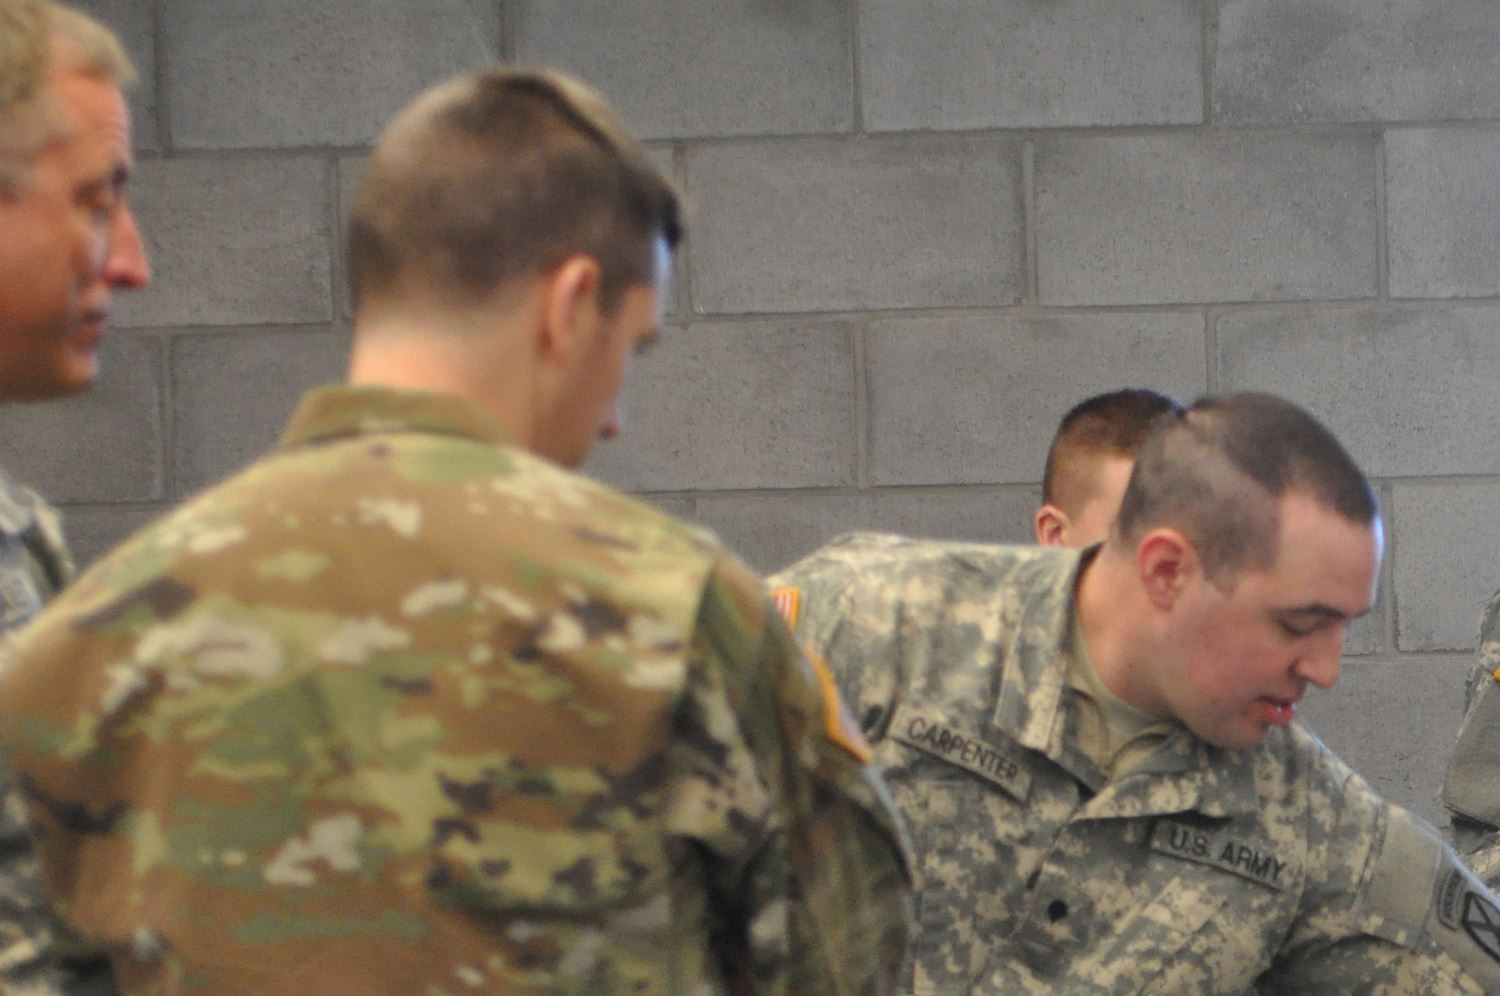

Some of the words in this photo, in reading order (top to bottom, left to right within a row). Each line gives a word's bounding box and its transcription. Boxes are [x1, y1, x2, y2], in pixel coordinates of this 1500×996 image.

[907, 717, 1019, 779] CARPENTER
[1169, 830, 1209, 855] U.S.
[1221, 841, 1286, 880] ARMY
